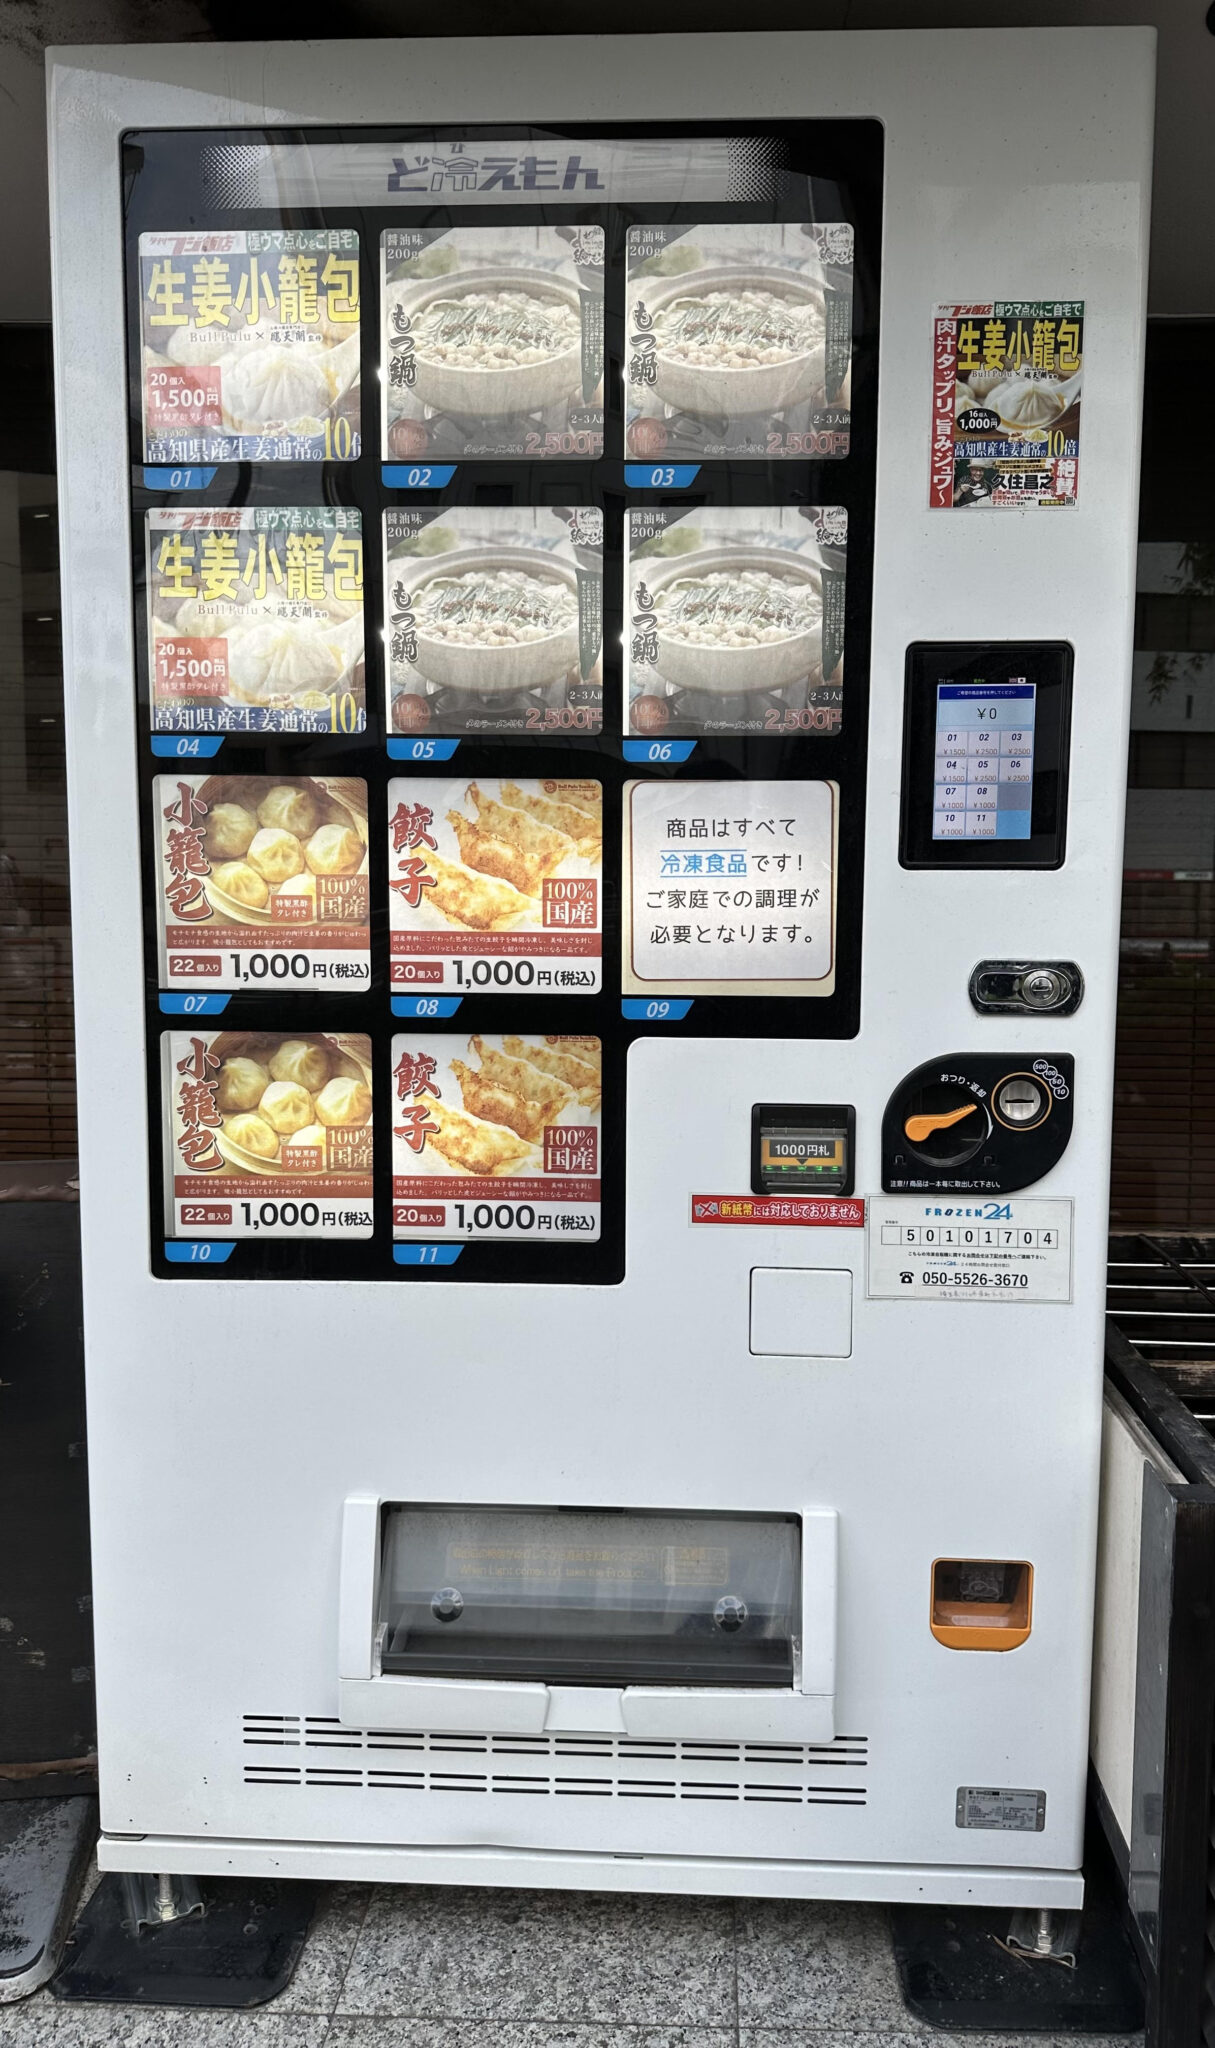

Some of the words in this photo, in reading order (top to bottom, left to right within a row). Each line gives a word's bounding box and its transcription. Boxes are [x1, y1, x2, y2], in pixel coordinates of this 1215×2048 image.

[388, 156, 605, 192] ど冷えもん
[248, 231, 359, 251] 極ウマ点心をご自宅
[387, 233, 424, 246] 醤油味
[630, 230, 667, 242] 醤油味
[387, 248, 419, 262] 200g
[629, 246, 663, 259] 200g
[147, 253, 360, 329] 生姜小籠包
[389, 303, 417, 386] もつ鍋
[629, 300, 658, 385] もつ鍋
[957, 319, 1081, 371] 生姜小籠包
[152, 389, 219, 411] 1,500円
[959, 418, 998, 430] 1,000円
[170, 470, 192, 488] 01
[408, 468, 432, 487] 02
[652, 468, 675, 486] 03
[992, 475, 1054, 489] 久住昌之
[387, 512, 423, 525] 醤油味
[631, 512, 668, 525] 醤油味
[387, 526, 419, 539] 200g
[631, 527, 663, 539] 200g
[156, 532, 363, 602] 生姜小籠包
[390, 580, 419, 663] もつ鍋
[632, 581, 660, 664] もつ鍋
[159, 659, 226, 680] 1,500円
[947, 734, 957, 742] 01
[979, 734, 989, 742] 02
[1011, 733, 1022, 741] 03
[176, 738, 200, 755] 04
[412, 741, 436, 759] 05
[648, 743, 672, 760] 06
[946, 761, 957, 769] 04
[978, 761, 989, 769] 05
[1010, 760, 1021, 768] 06
[945, 787, 956, 795] 07
[977, 787, 988, 795] 08
[945, 814, 955, 822] 10
[976, 814, 986, 822] 11
[666, 818, 797, 839] 商品はすべて
[163, 781, 213, 922] 小籠包
[388, 801, 437, 909] 餃子
[660, 853, 803, 875] 冷凍食品です!
[319, 878, 366, 895] 100%
[545, 881, 594, 900] 100%
[646, 888, 820, 909] ご家庭での調理が
[276, 909, 308, 918] タレ付き
[319, 895, 366, 920] 国産
[545, 900, 594, 926] 国産
[650, 924, 813, 944] 必要となります。
[172, 959, 219, 973] 22個入り
[393, 965, 441, 979] 20個入り
[183, 996, 207, 1012] 07
[416, 999, 439, 1015] 08
[646, 1002, 670, 1018] 09
[1034, 1063, 1048, 1071] 500
[940, 1073, 987, 1098] おつり・返却
[176, 1037, 225, 1172] 小籠包
[392, 1052, 441, 1154] 餃子
[328, 1128, 373, 1145] 100%
[547, 1129, 594, 1146] 100%
[329, 1145, 373, 1169] 国産
[775, 1144, 830, 1156] 1000円札
[286, 1159, 317, 1168] タレ付き
[546, 1147, 594, 1171] 国産
[184, 1208, 230, 1222] 22個入り
[396, 1209, 443, 1223] 20個入り
[720, 1201, 861, 1220] 新紙幣には対応しておりません
[190, 1244, 211, 1260] 10
[419, 1247, 438, 1263] 11
[922, 1271, 1029, 1287] 050-5526-3670
